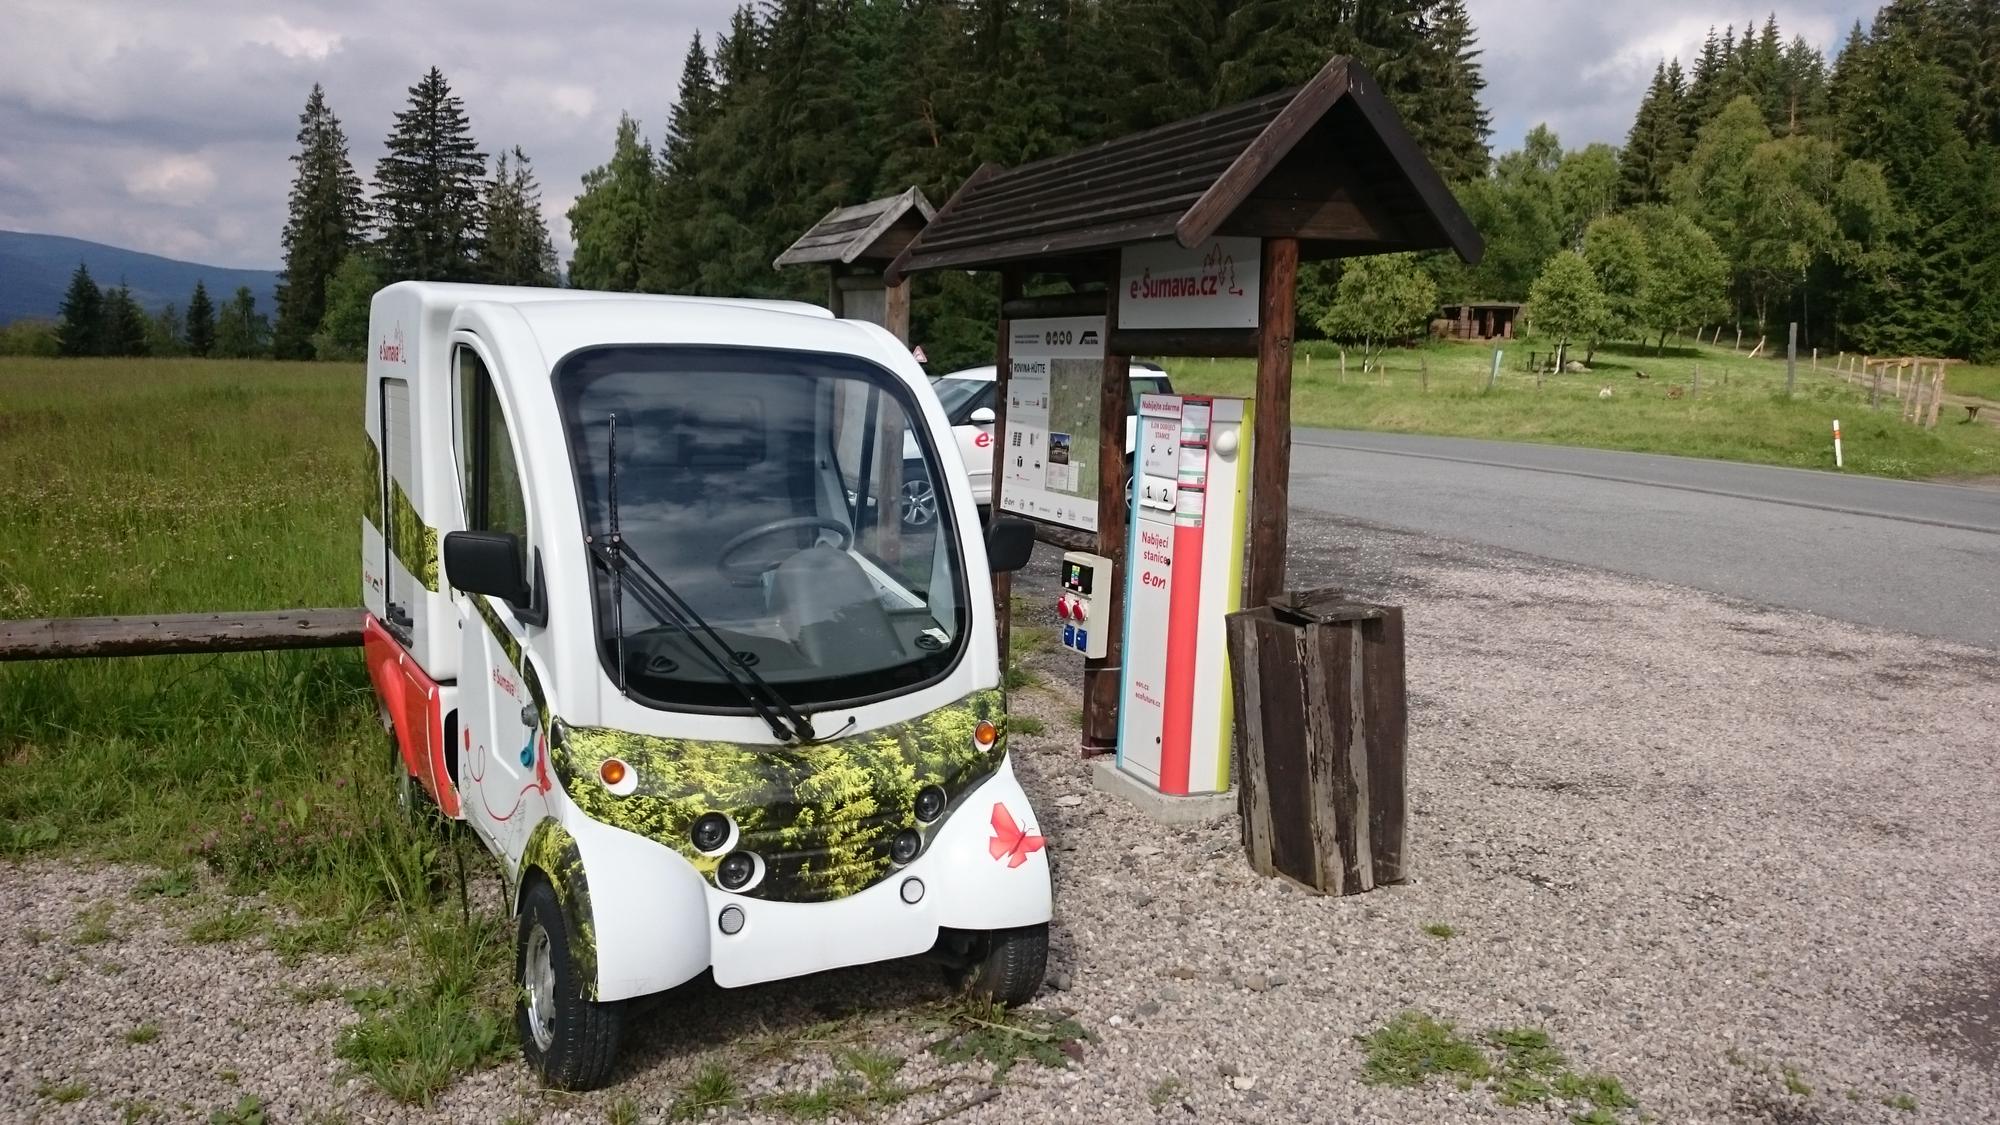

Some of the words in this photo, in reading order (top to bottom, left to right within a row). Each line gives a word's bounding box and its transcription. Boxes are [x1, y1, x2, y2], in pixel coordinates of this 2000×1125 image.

[1162, 402, 1180, 412] zdarma
[1146, 485, 1152, 499] 1
[1162, 488, 1169, 502] 2
[1142, 531, 1169, 549] Nabíjecí
[1143, 551, 1168, 564] stanice
